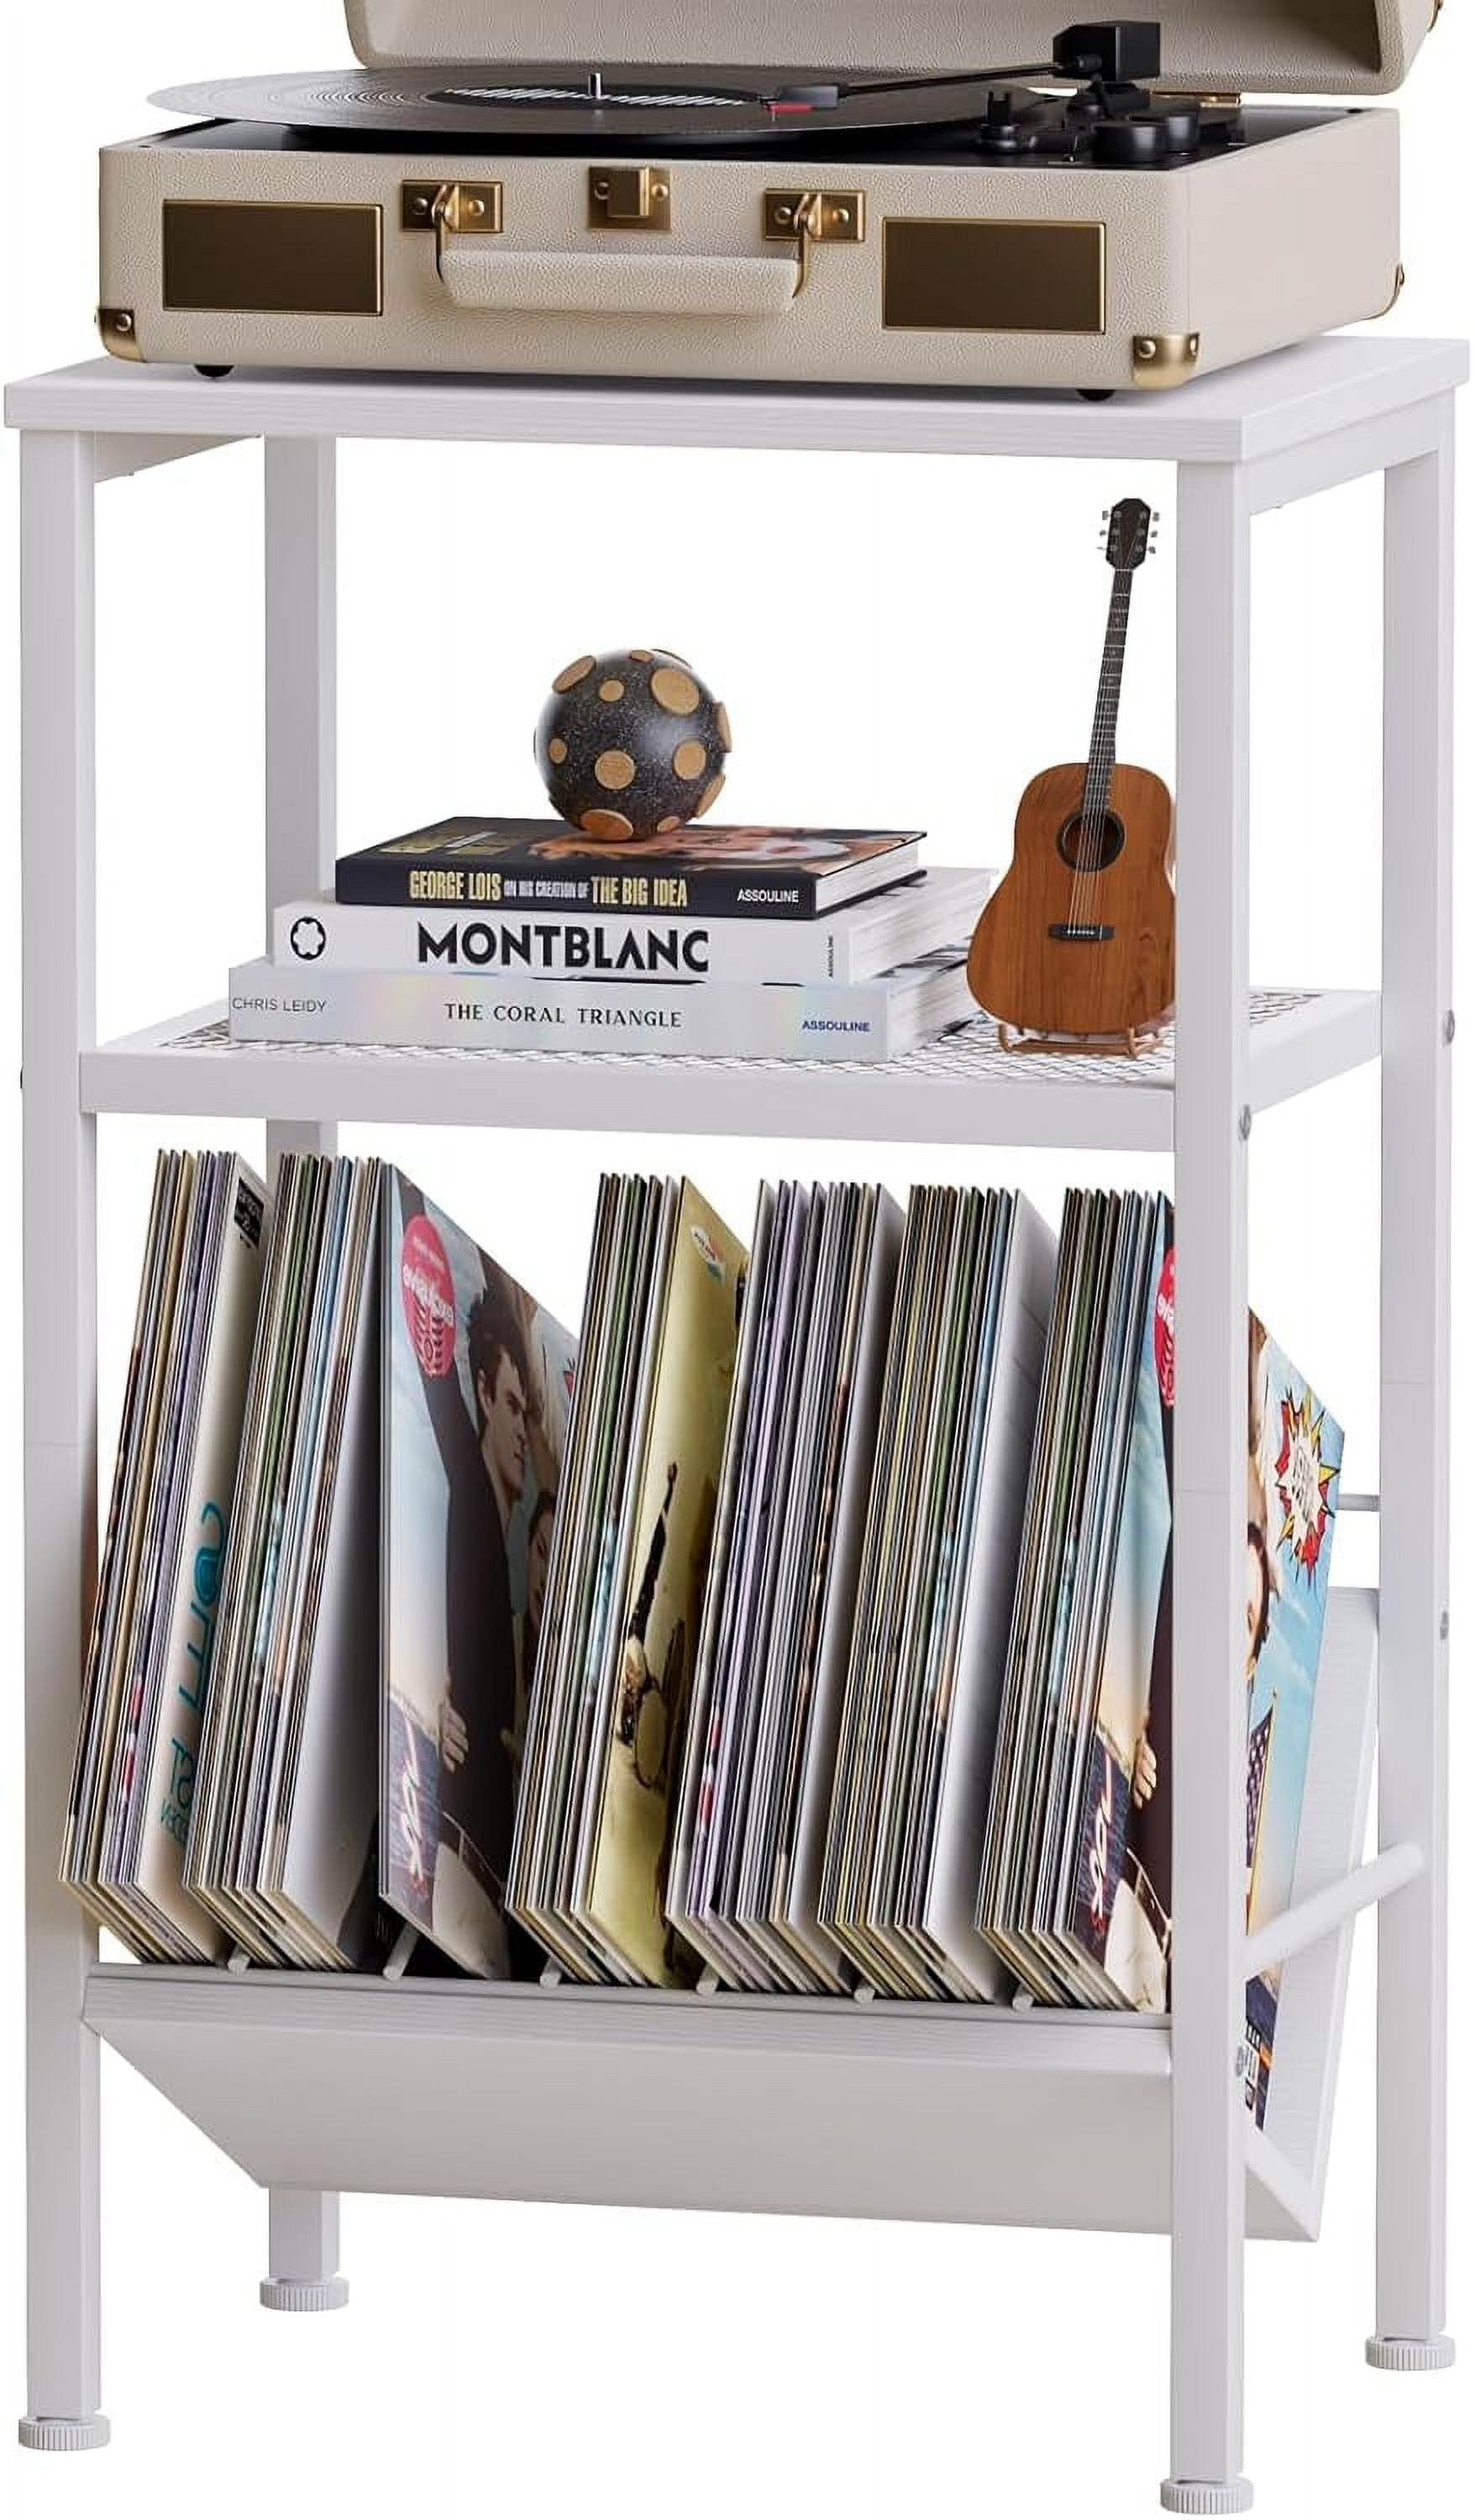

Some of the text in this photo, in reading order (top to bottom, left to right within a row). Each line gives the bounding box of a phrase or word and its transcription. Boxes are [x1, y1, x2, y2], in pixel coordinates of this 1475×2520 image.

[410, 870, 464, 900] GEORGE
[468, 872, 501, 900] LOIS
[591, 875, 619, 904] THE
[622, 877, 648, 906] BIG
[654, 878, 688, 907] IDEA
[737, 888, 800, 903] ASSOULINE
[417, 921, 709, 973] MONTBLANC
[232, 997, 327, 1013] CHRIS LEIDY
[444, 1003, 682, 1028] THE CORAL TRIANGLE
[801, 1020, 870, 1032] ASSOULINE
